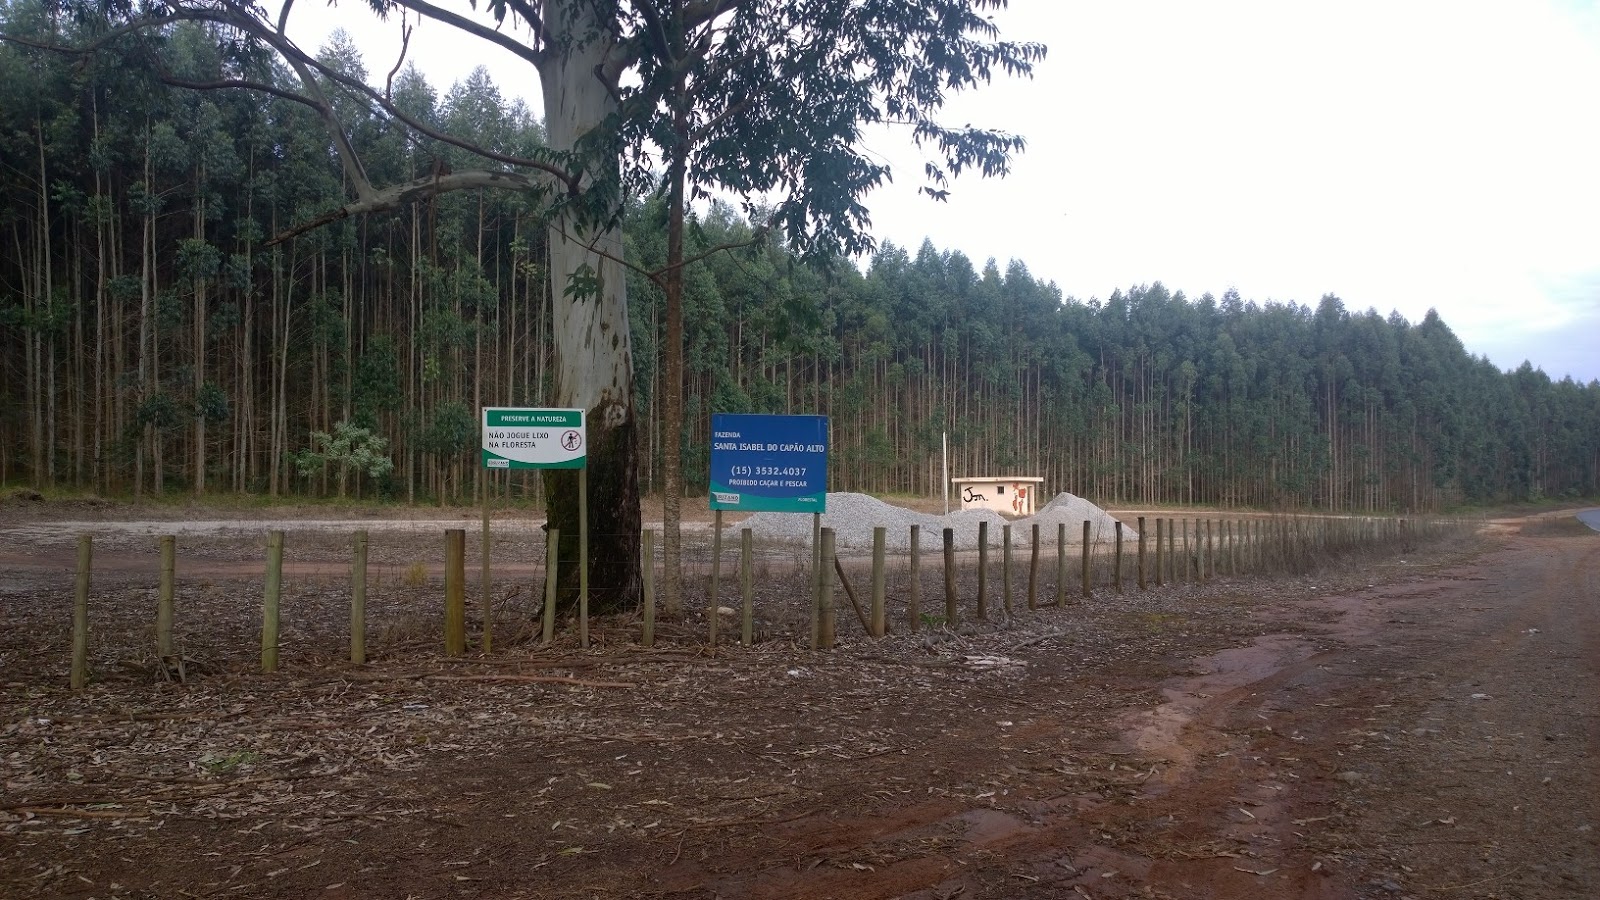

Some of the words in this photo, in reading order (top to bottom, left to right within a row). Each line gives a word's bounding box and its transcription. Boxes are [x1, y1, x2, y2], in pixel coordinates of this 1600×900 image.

[488, 431, 504, 439] NÃO
[714, 442, 737, 451] SANTA
[738, 443, 765, 451] ISABEL
[767, 443, 778, 452] DO
[780, 442, 804, 452] CAPÃO
[806, 444, 825, 453] ALTO
[731, 465, 752, 477] (15)
[755, 467, 807, 476] 3532.4037
[759, 479, 778, 487] CAÇAR
